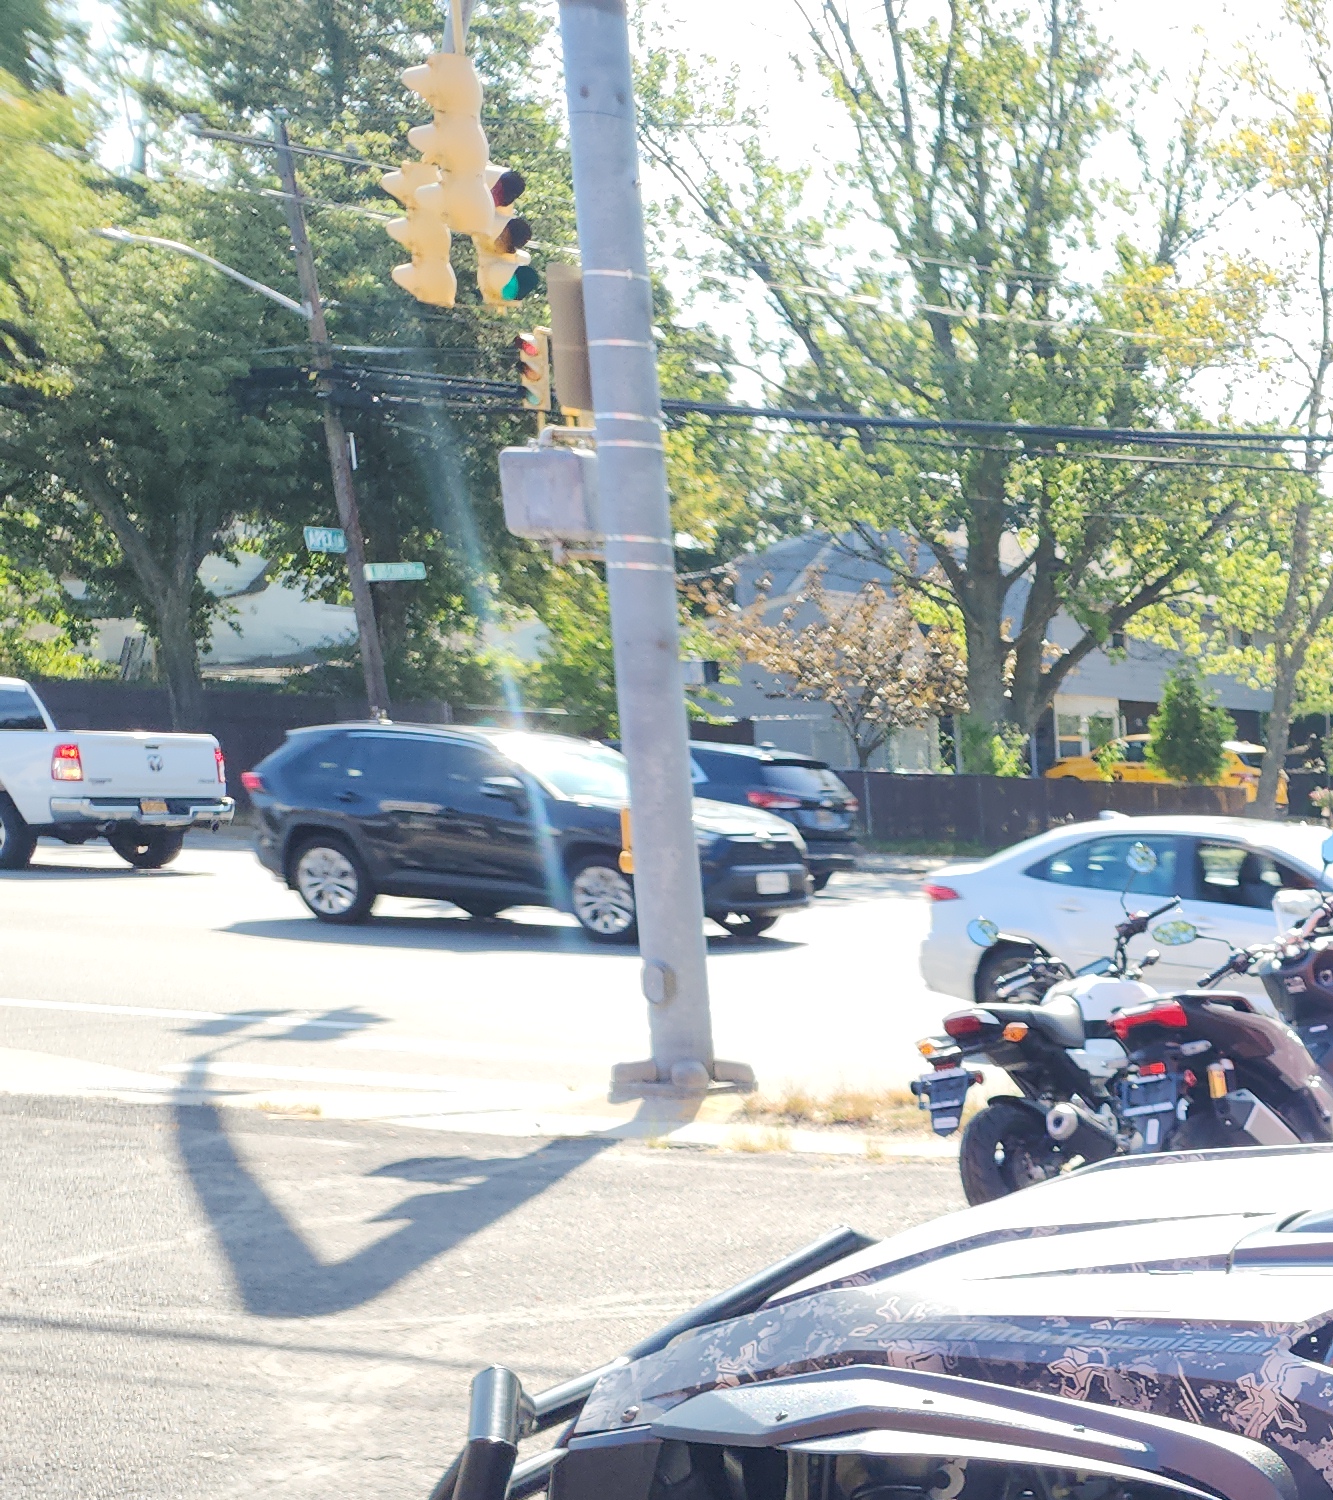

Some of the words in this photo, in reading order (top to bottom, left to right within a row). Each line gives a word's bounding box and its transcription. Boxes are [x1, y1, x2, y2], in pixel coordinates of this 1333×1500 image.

[868, 1322, 950, 1342] Dual
[946, 1323, 1051, 1345] Clutch
[1054, 1328, 1274, 1353] Transmission
